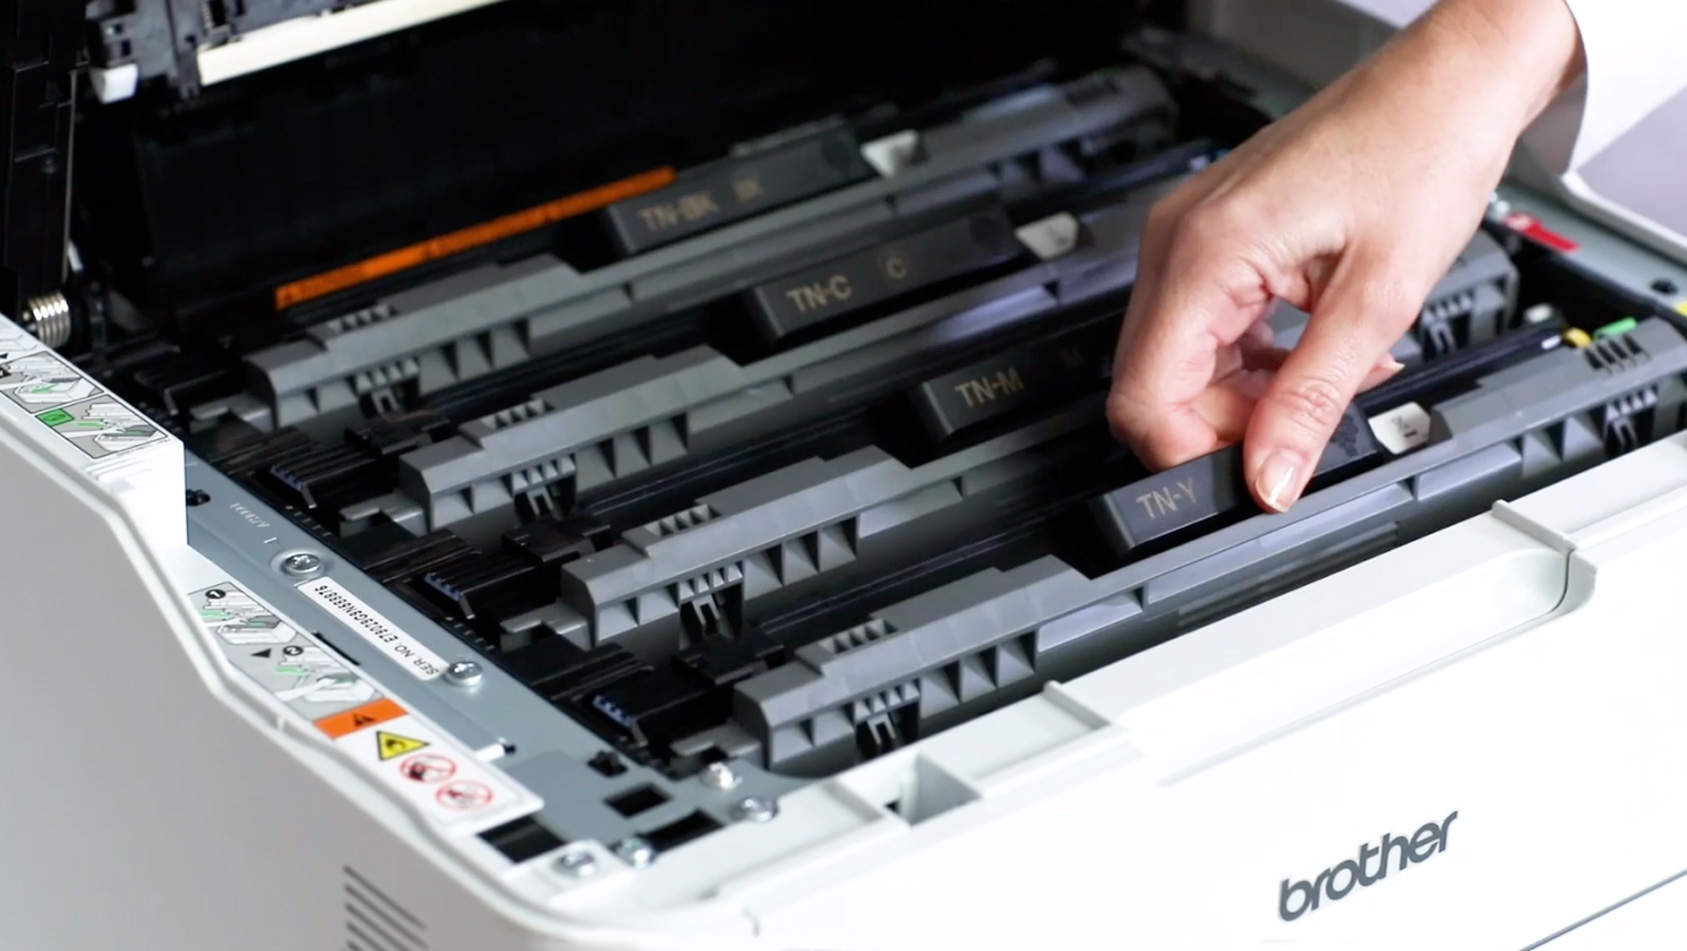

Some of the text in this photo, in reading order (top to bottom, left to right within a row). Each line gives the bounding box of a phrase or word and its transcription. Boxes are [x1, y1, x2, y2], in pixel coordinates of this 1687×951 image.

[786, 274, 852, 312] TN-C
[954, 367, 1024, 408] TN-M
[1135, 478, 1197, 519] TN-Y
[1279, 810, 1458, 921] brother
